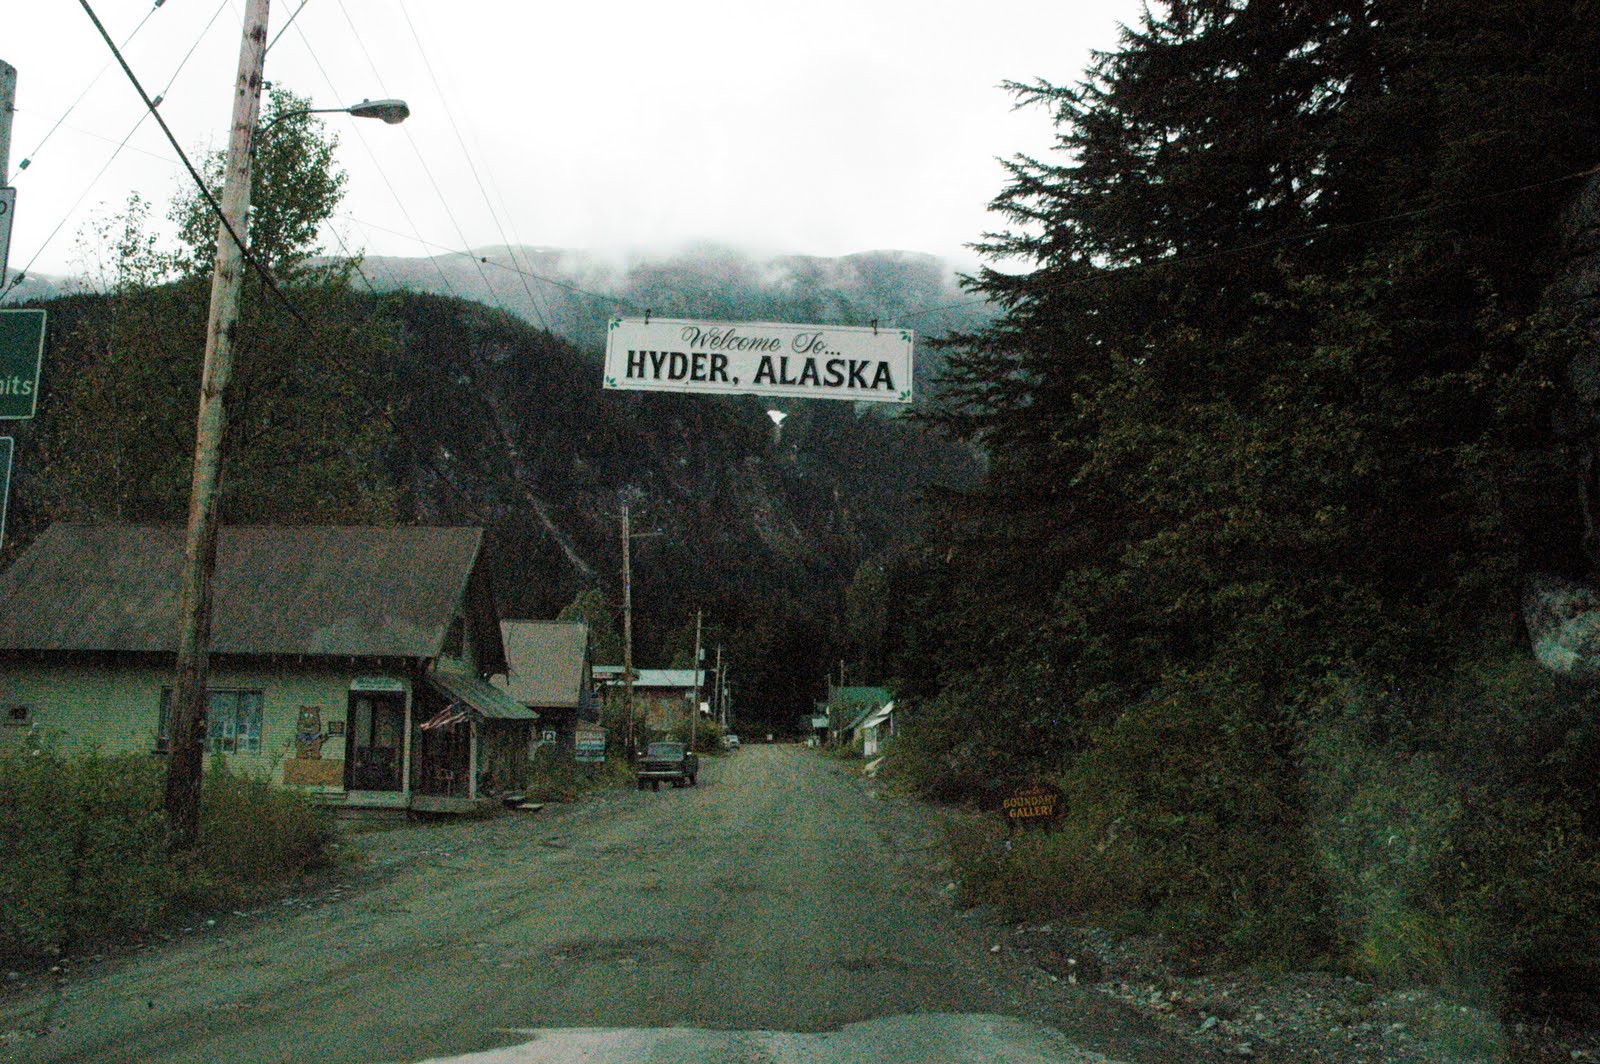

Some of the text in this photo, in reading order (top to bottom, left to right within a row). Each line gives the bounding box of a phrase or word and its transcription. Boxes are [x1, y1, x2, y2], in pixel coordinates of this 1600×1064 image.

[681, 326, 841, 356] Welcome To...
[626, 350, 895, 390] HYDER, ALASKA
[1003, 795, 1057, 808] BOUNDARY
[1009, 806, 1053, 818] GALLERY
